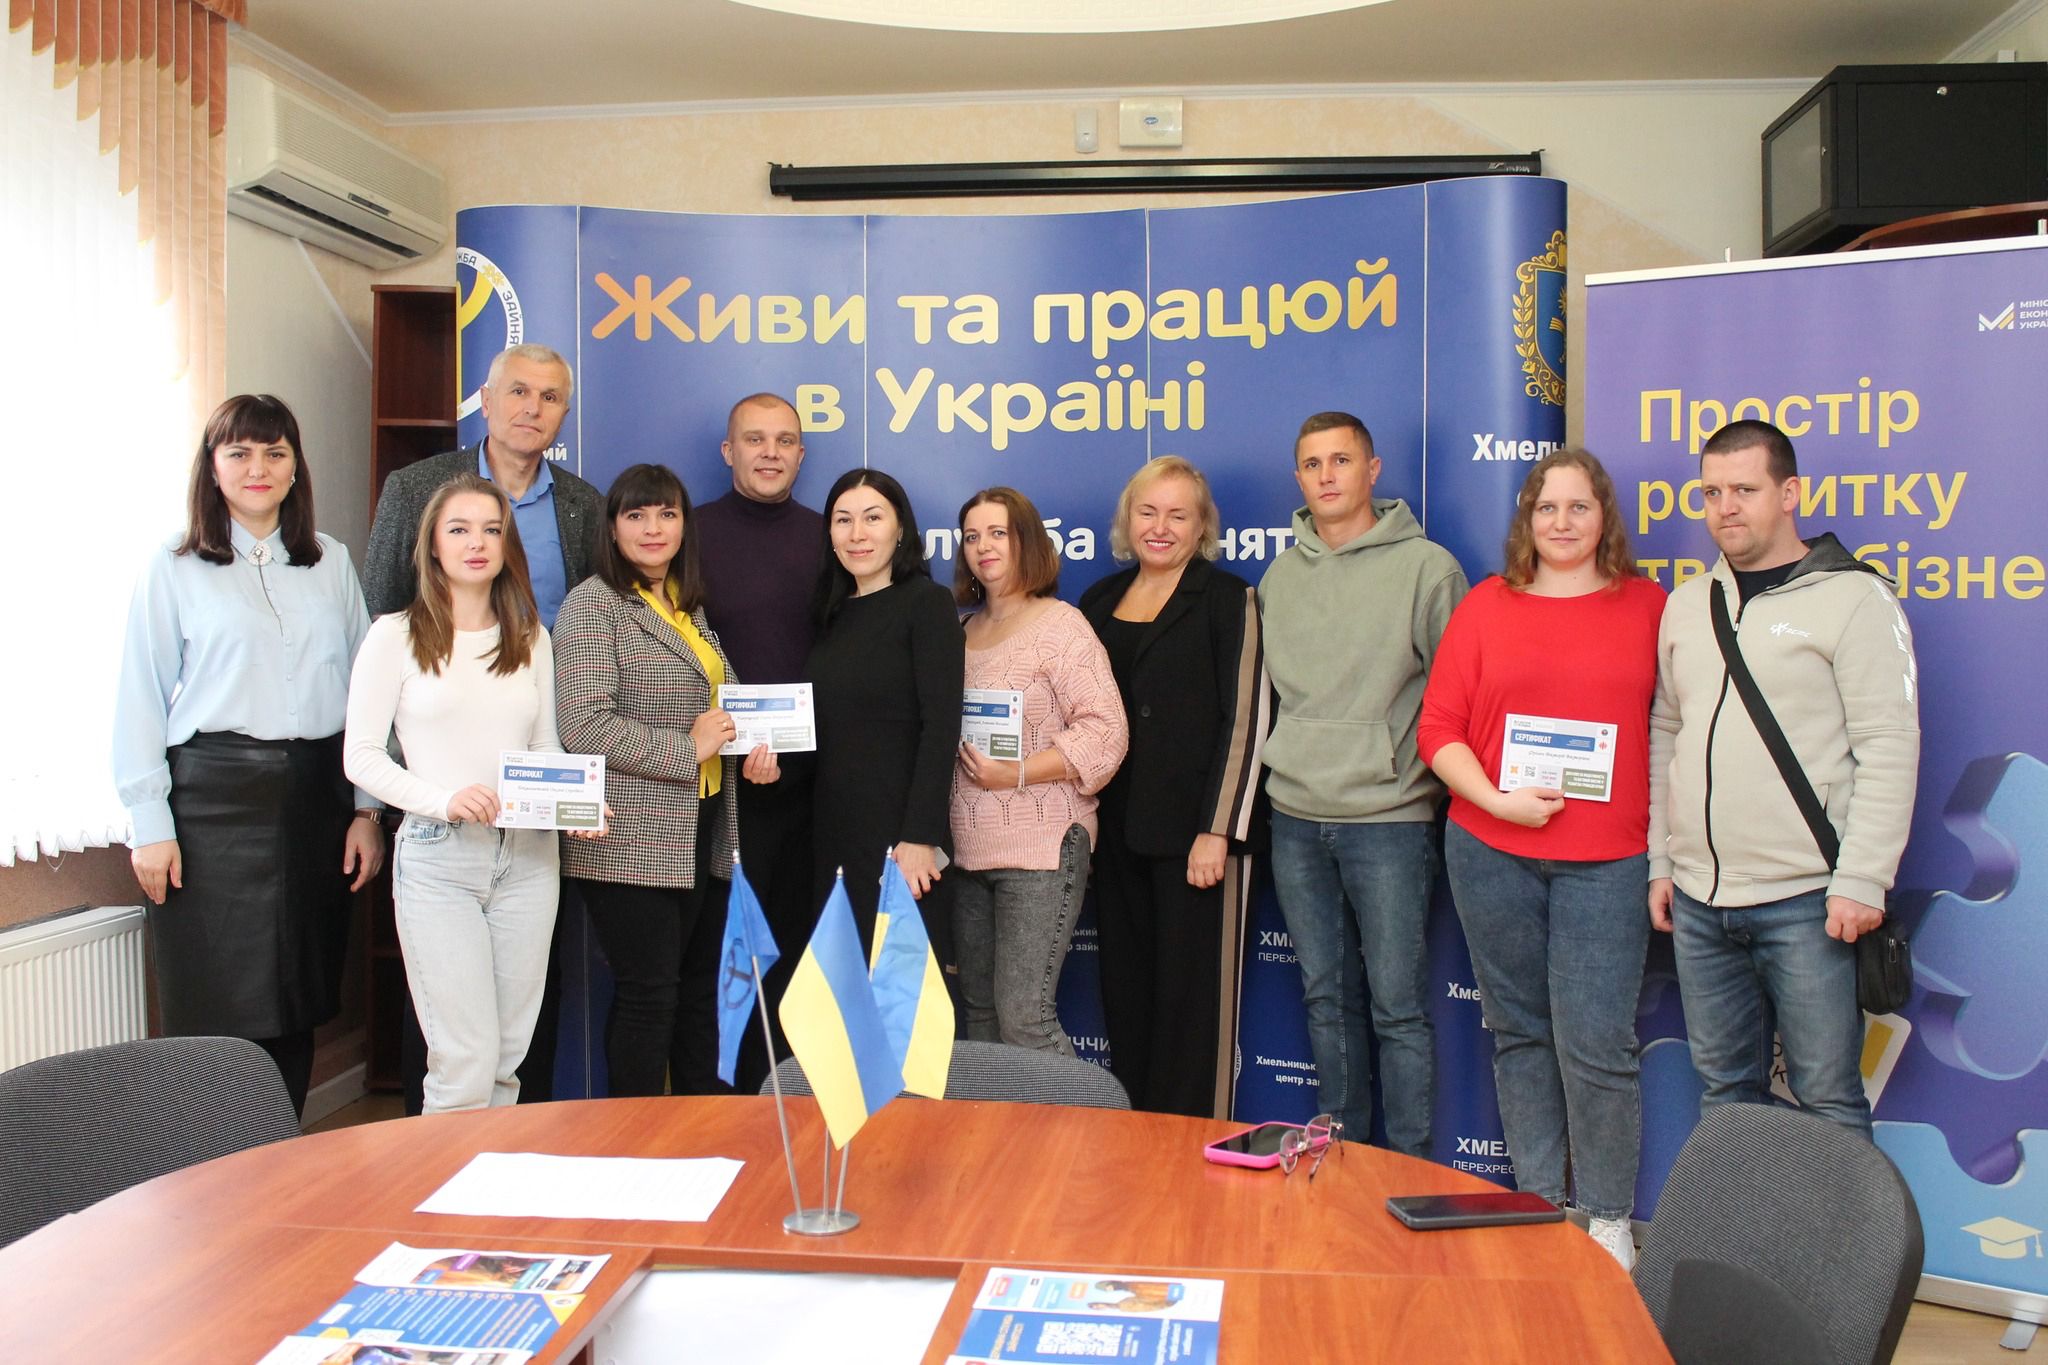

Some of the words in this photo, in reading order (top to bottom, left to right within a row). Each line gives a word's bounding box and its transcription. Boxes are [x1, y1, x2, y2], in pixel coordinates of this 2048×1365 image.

[592, 272, 865, 345] Живи
[897, 294, 1000, 344] та
[1033, 257, 1398, 360] працюй
[796, 384, 845, 433] в
[875, 360, 1206, 451] Україні
[1640, 376, 1920, 454] Простір
[1638, 471, 1968, 535] роитку
[1275, 1073, 1303, 1086] центр
